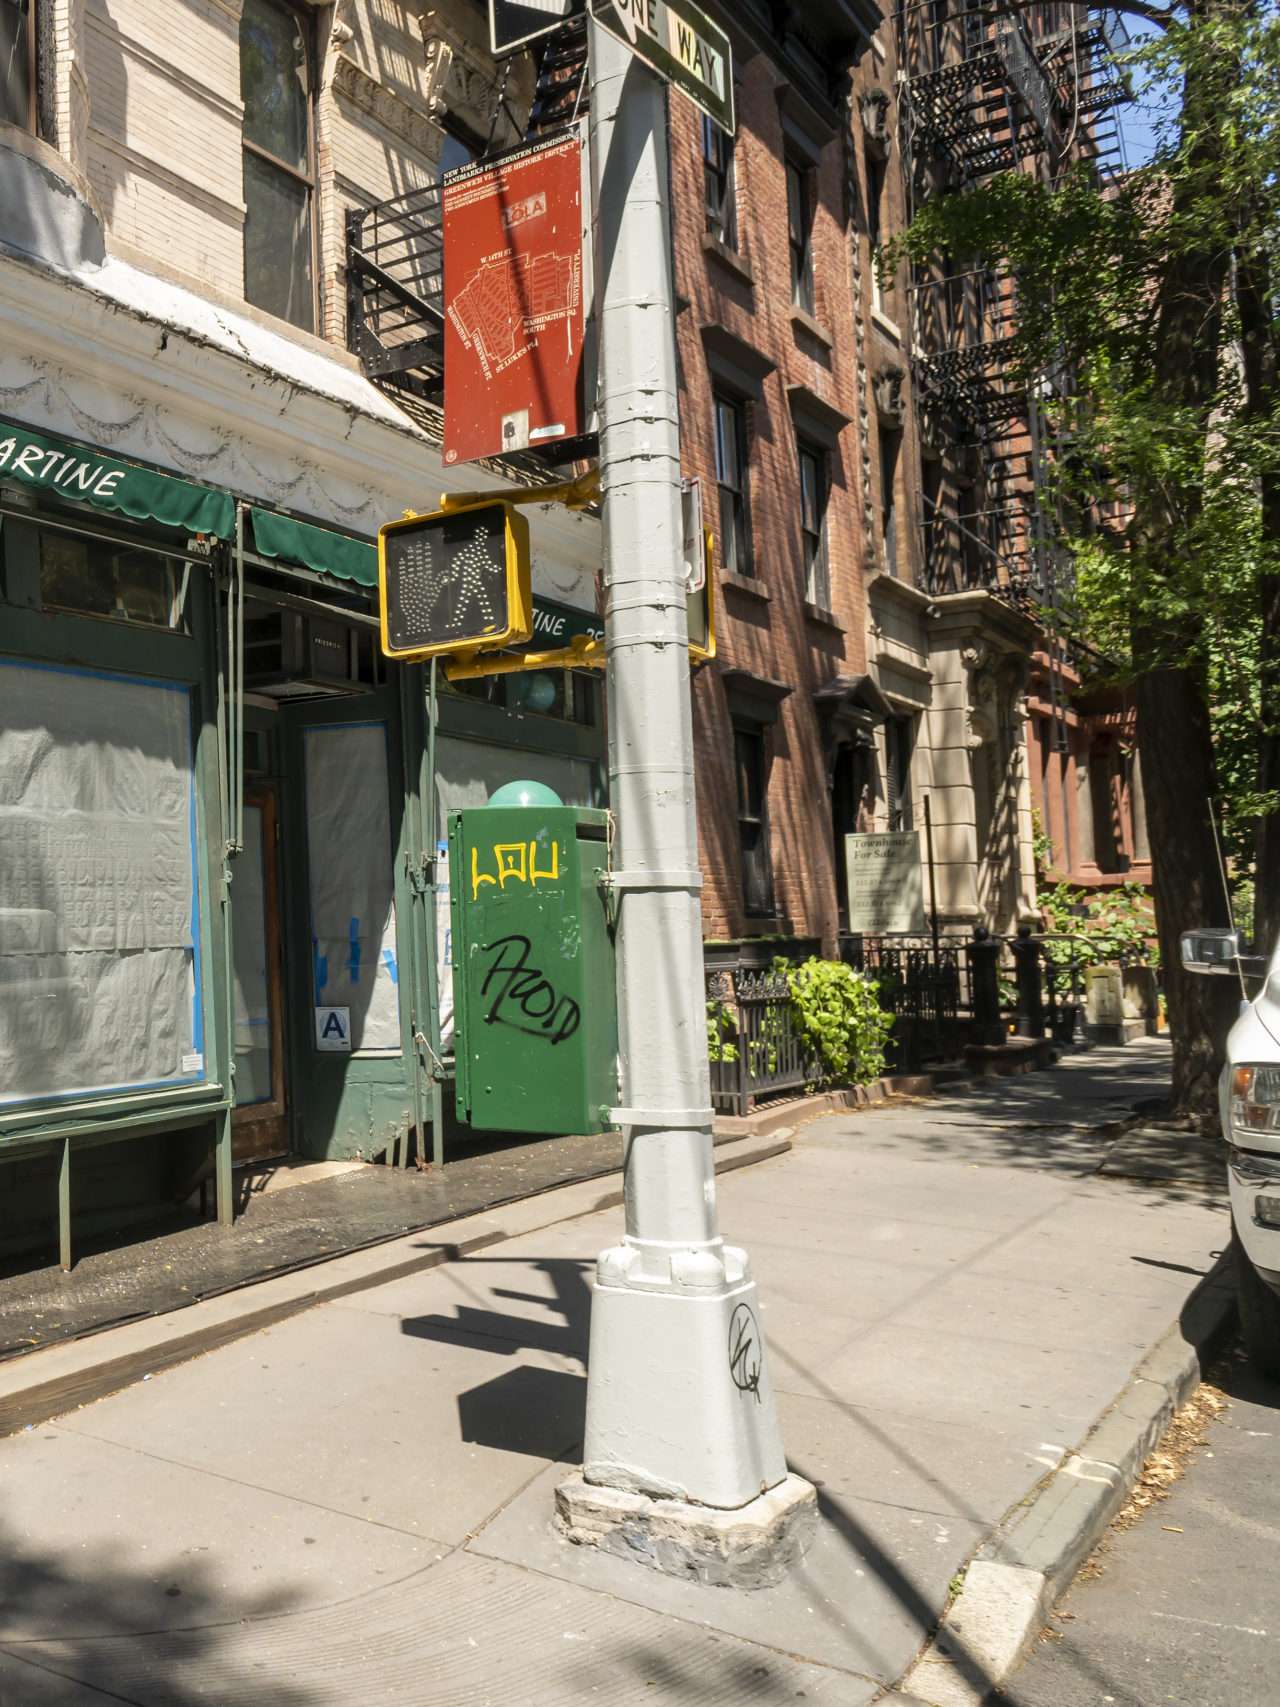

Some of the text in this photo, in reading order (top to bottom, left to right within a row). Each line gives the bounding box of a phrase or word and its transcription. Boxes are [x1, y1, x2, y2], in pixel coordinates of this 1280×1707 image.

[618, 0, 716, 86] NE WAY
[443, 133, 575, 187] LANDMARKS PRESERVATION COMMISSION
[443, 162, 478, 179] NEW YORK
[444, 143, 576, 196] GREENWICH VILLAGE HISTORIC DISTRICT
[523, 311, 566, 327] WASHINGTON
[854, 850, 872, 860] For
[322, 1012, 345, 1039] A
